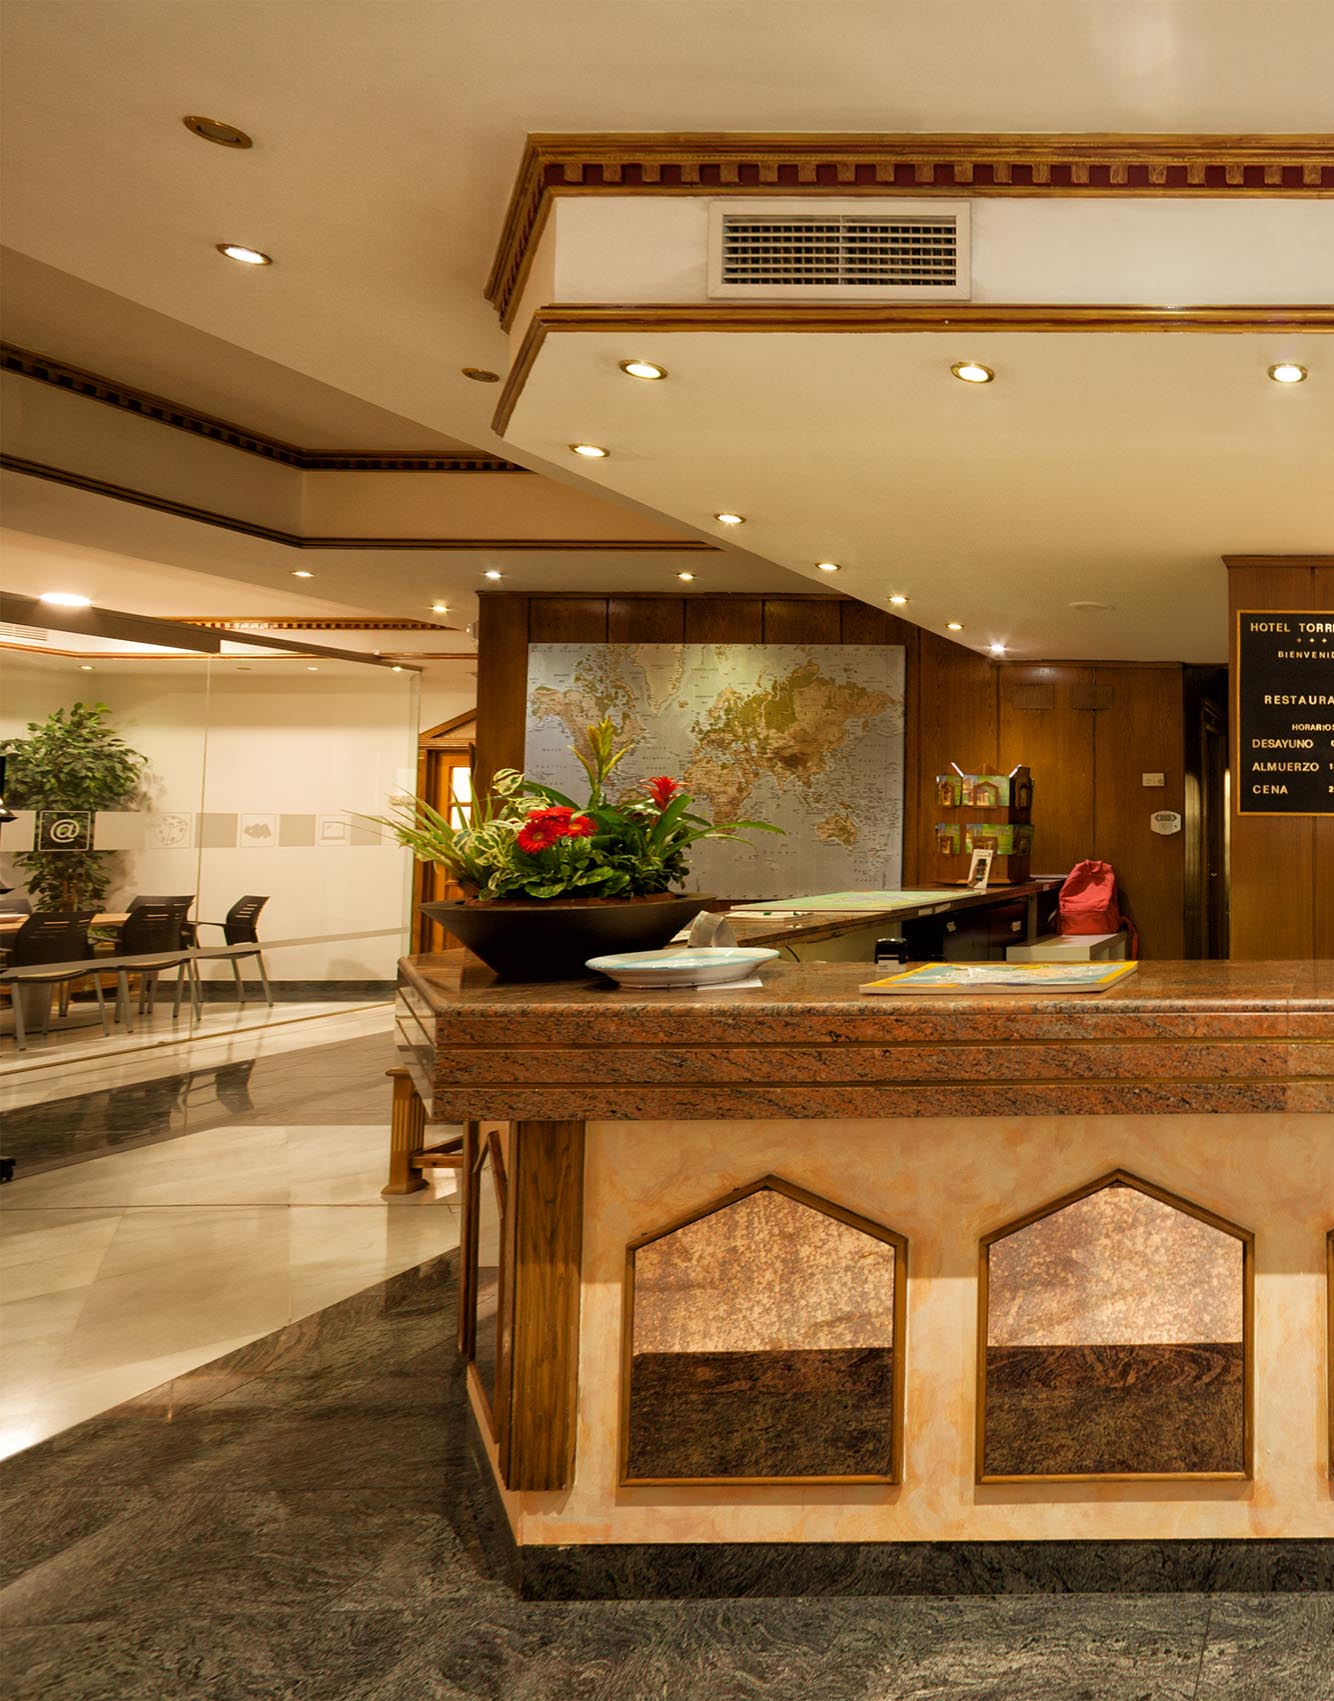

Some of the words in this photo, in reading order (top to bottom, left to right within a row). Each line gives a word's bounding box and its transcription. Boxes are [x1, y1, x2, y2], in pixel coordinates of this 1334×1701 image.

[1250, 622, 1291, 633] HOTEL
[1251, 738, 1314, 749] DESAYUNO
[1251, 761, 1320, 772] ALMUERZO
[1252, 784, 1289, 795] CENA
